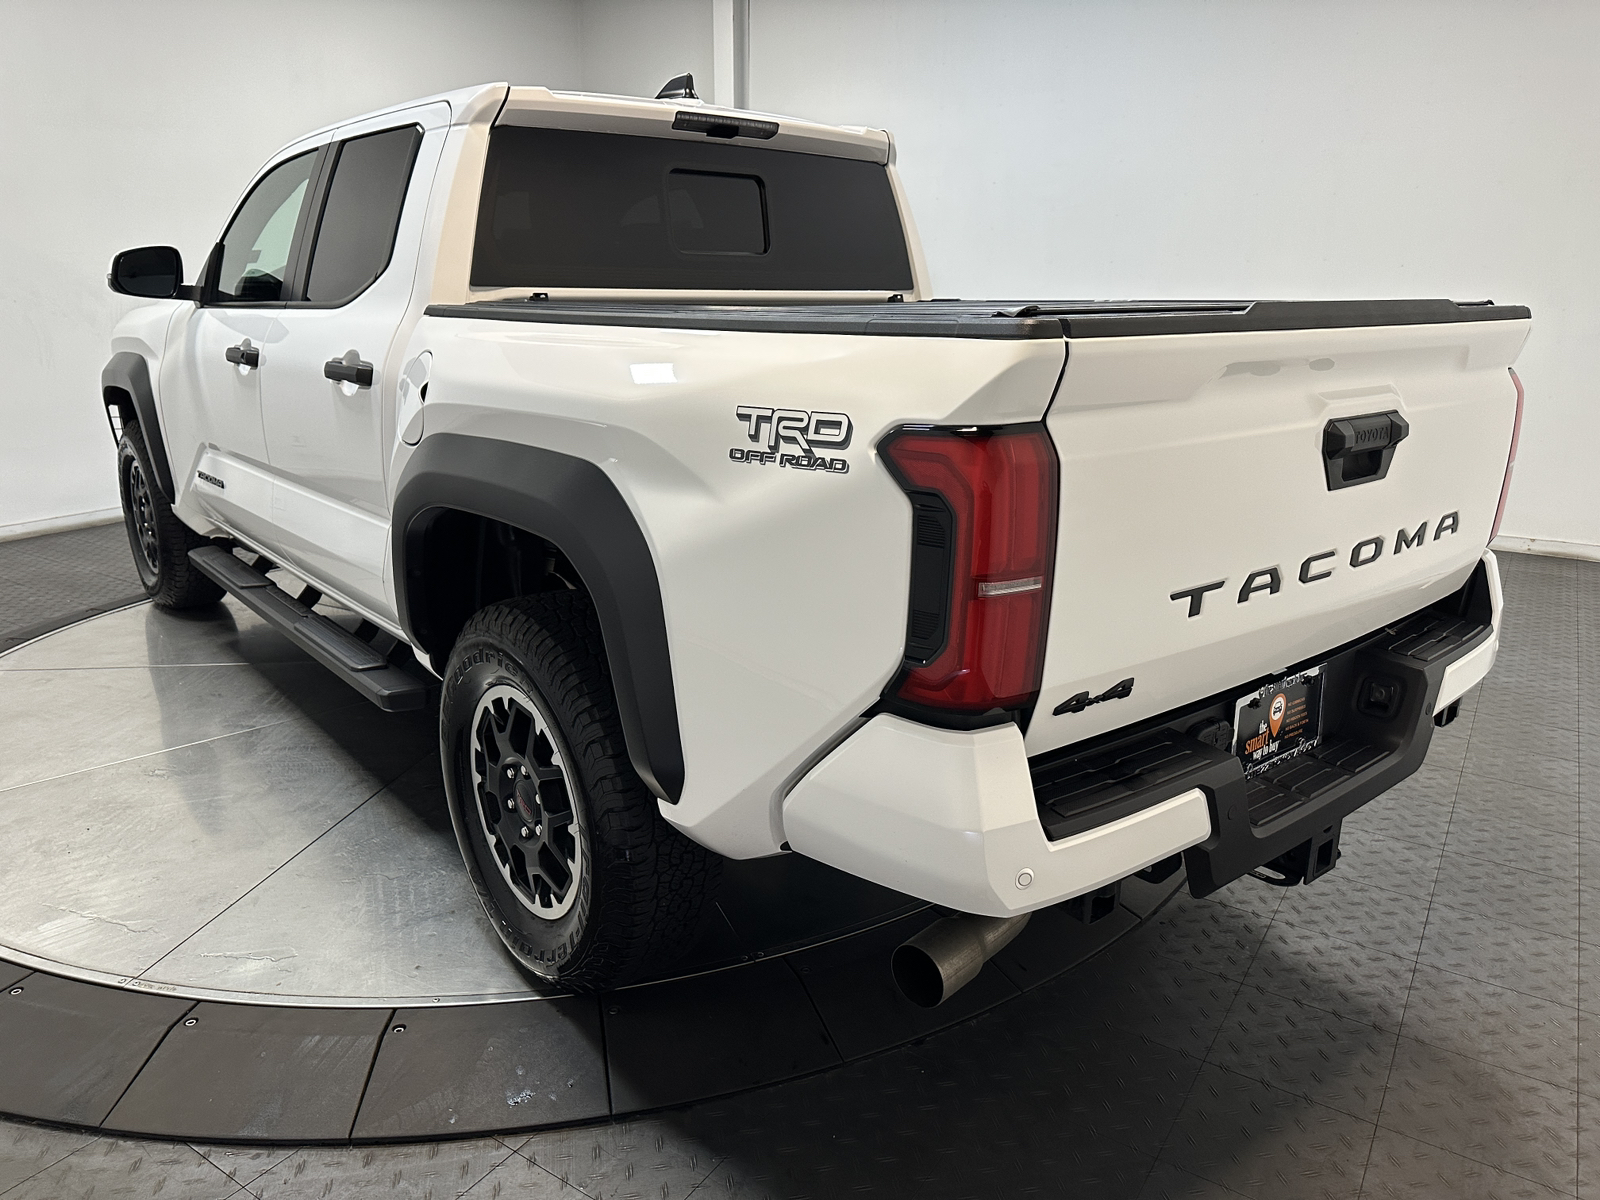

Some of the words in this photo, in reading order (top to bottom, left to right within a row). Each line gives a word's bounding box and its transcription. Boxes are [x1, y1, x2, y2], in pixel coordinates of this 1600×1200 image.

[736, 405, 854, 456] TRD
[1355, 426, 1389, 444] TOYOTA
[728, 448, 776, 465] OFF
[779, 453, 850, 474] ROAD
[1170, 510, 1460, 618] TACOMA
[1259, 720, 1268, 733] the
[1245, 727, 1270, 755] smart
[1252, 747, 1263, 760] way
[1262, 744, 1268, 756] to
[1269, 739, 1281, 754] buy
